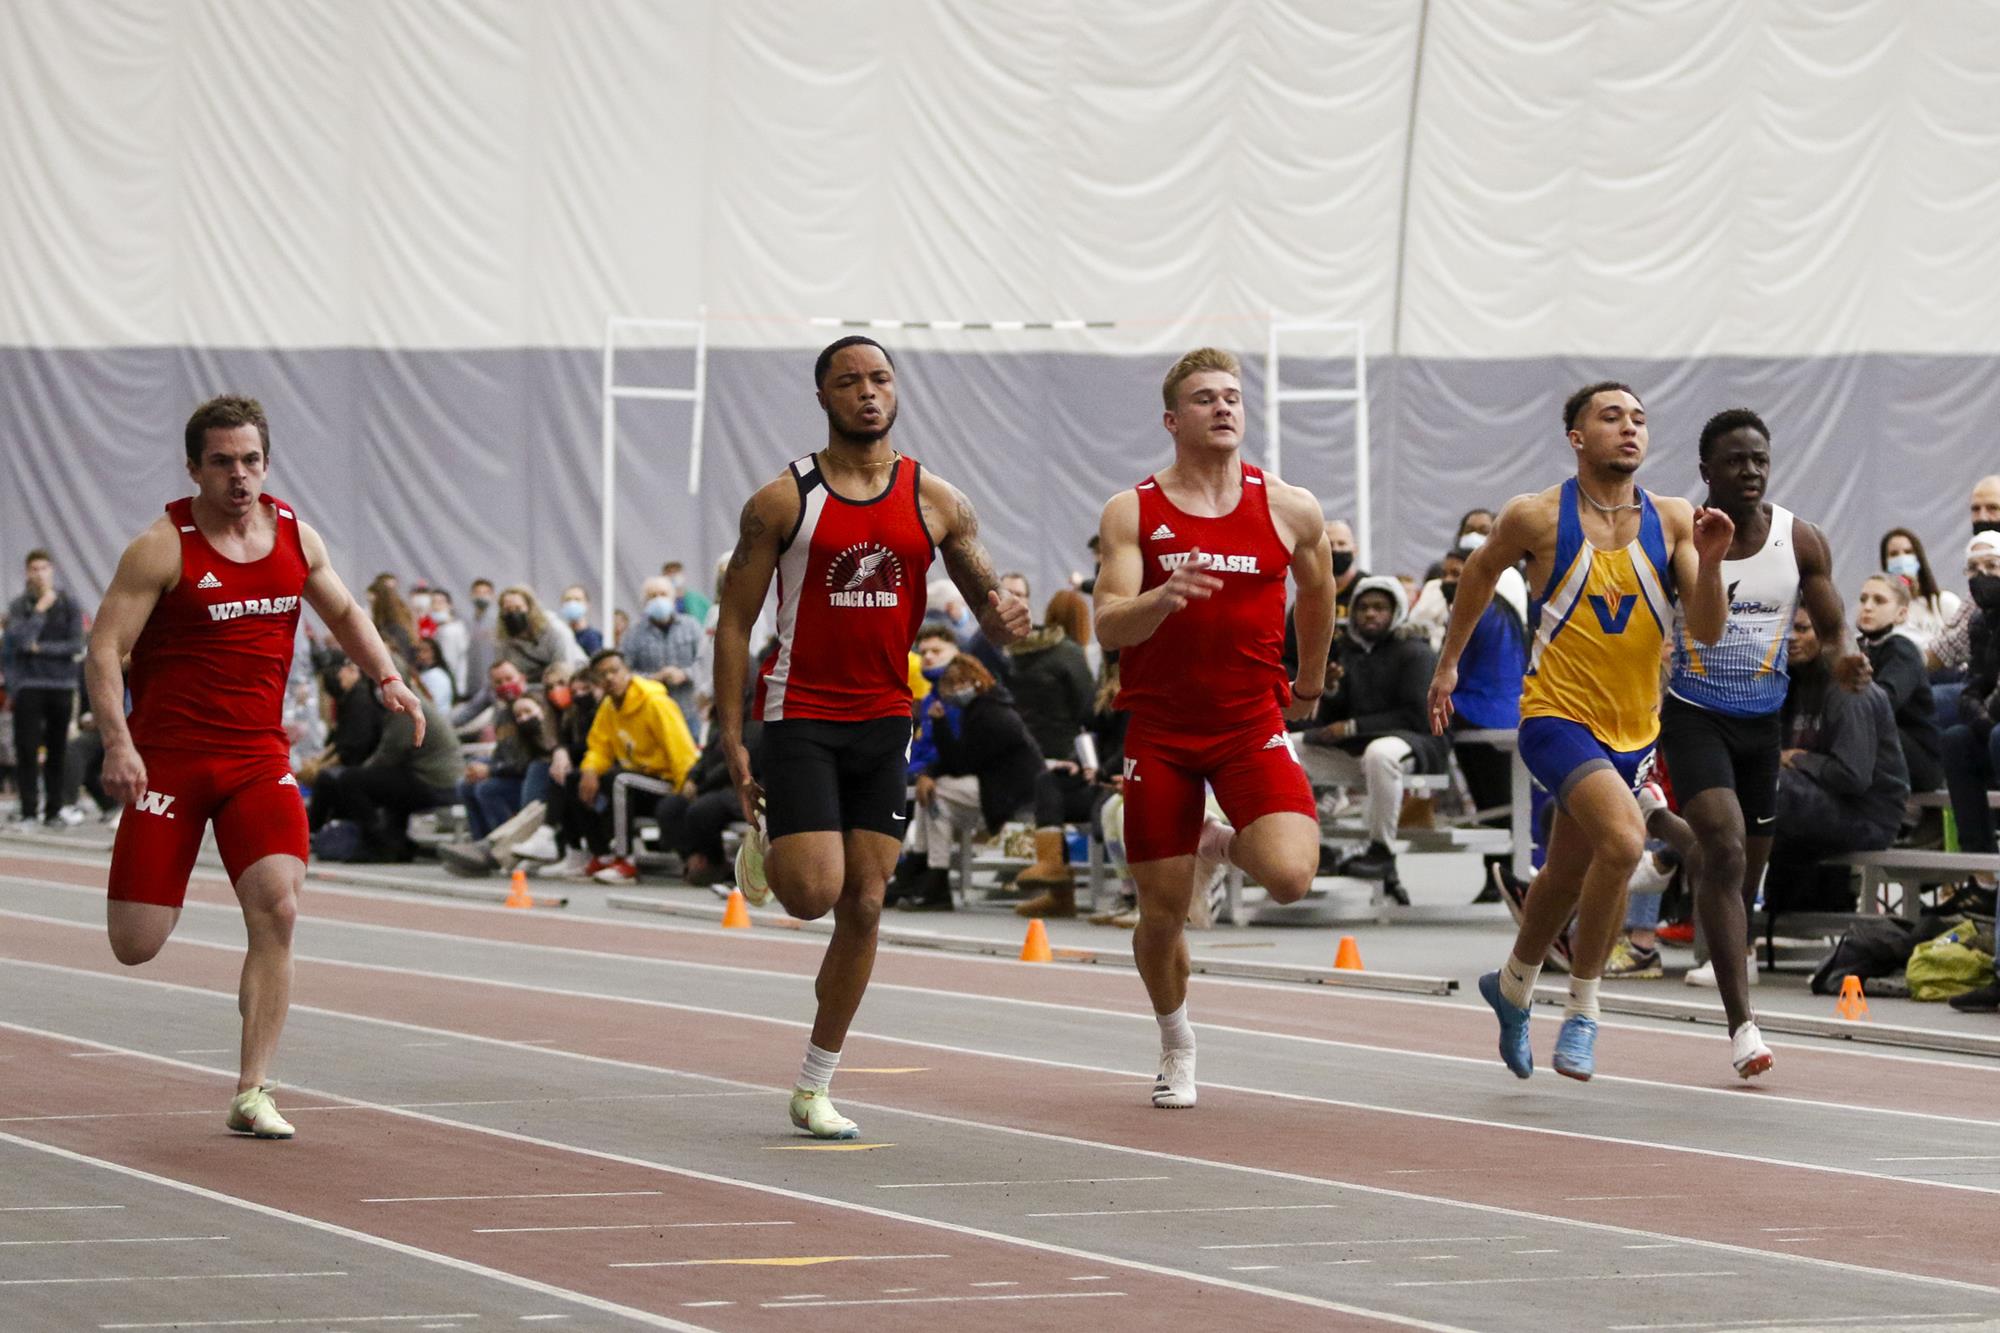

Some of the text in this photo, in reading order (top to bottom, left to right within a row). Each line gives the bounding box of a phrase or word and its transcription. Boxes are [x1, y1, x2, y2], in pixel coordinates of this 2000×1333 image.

[1158, 552, 1260, 574] WBASH.
[829, 590, 898, 608] TRACK & FIELD
